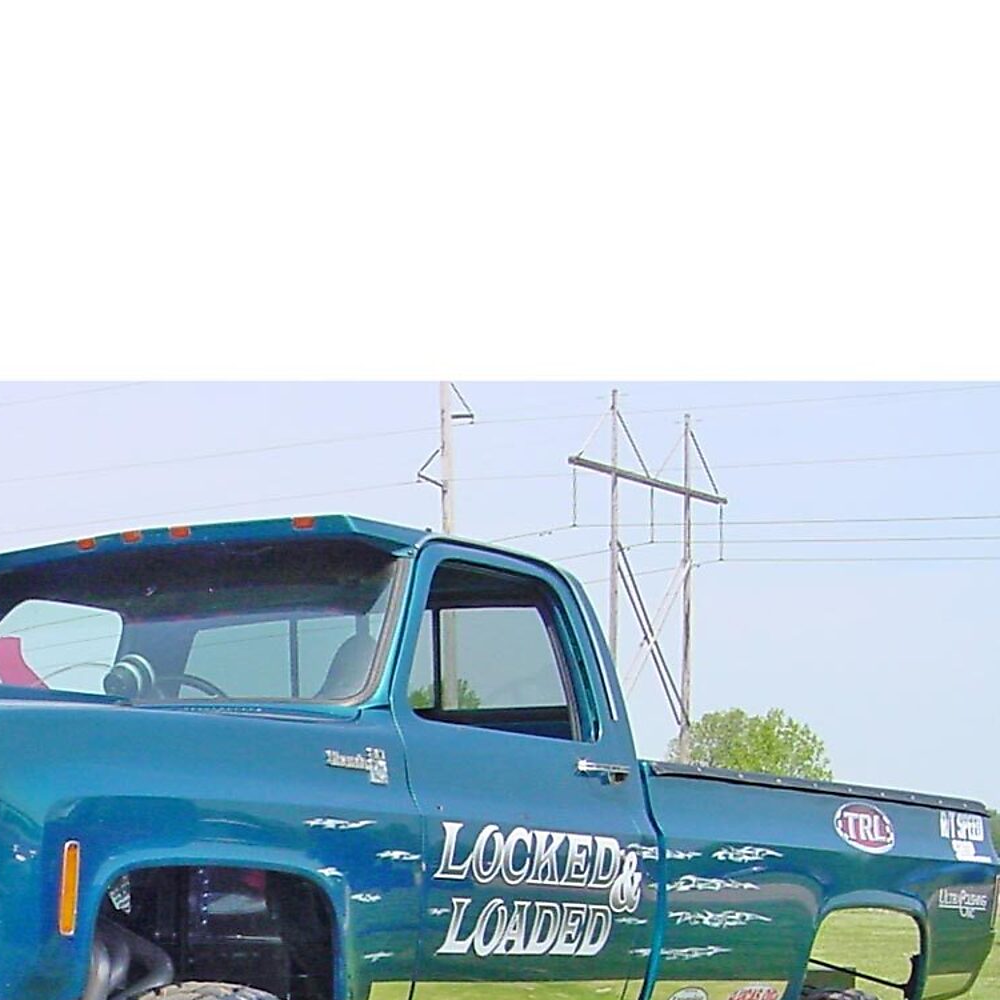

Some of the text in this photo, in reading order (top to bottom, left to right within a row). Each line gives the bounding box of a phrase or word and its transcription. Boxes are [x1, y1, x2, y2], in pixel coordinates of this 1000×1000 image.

[434, 821, 642, 913] LOCKED &
[434, 897, 612, 957] LOADED
